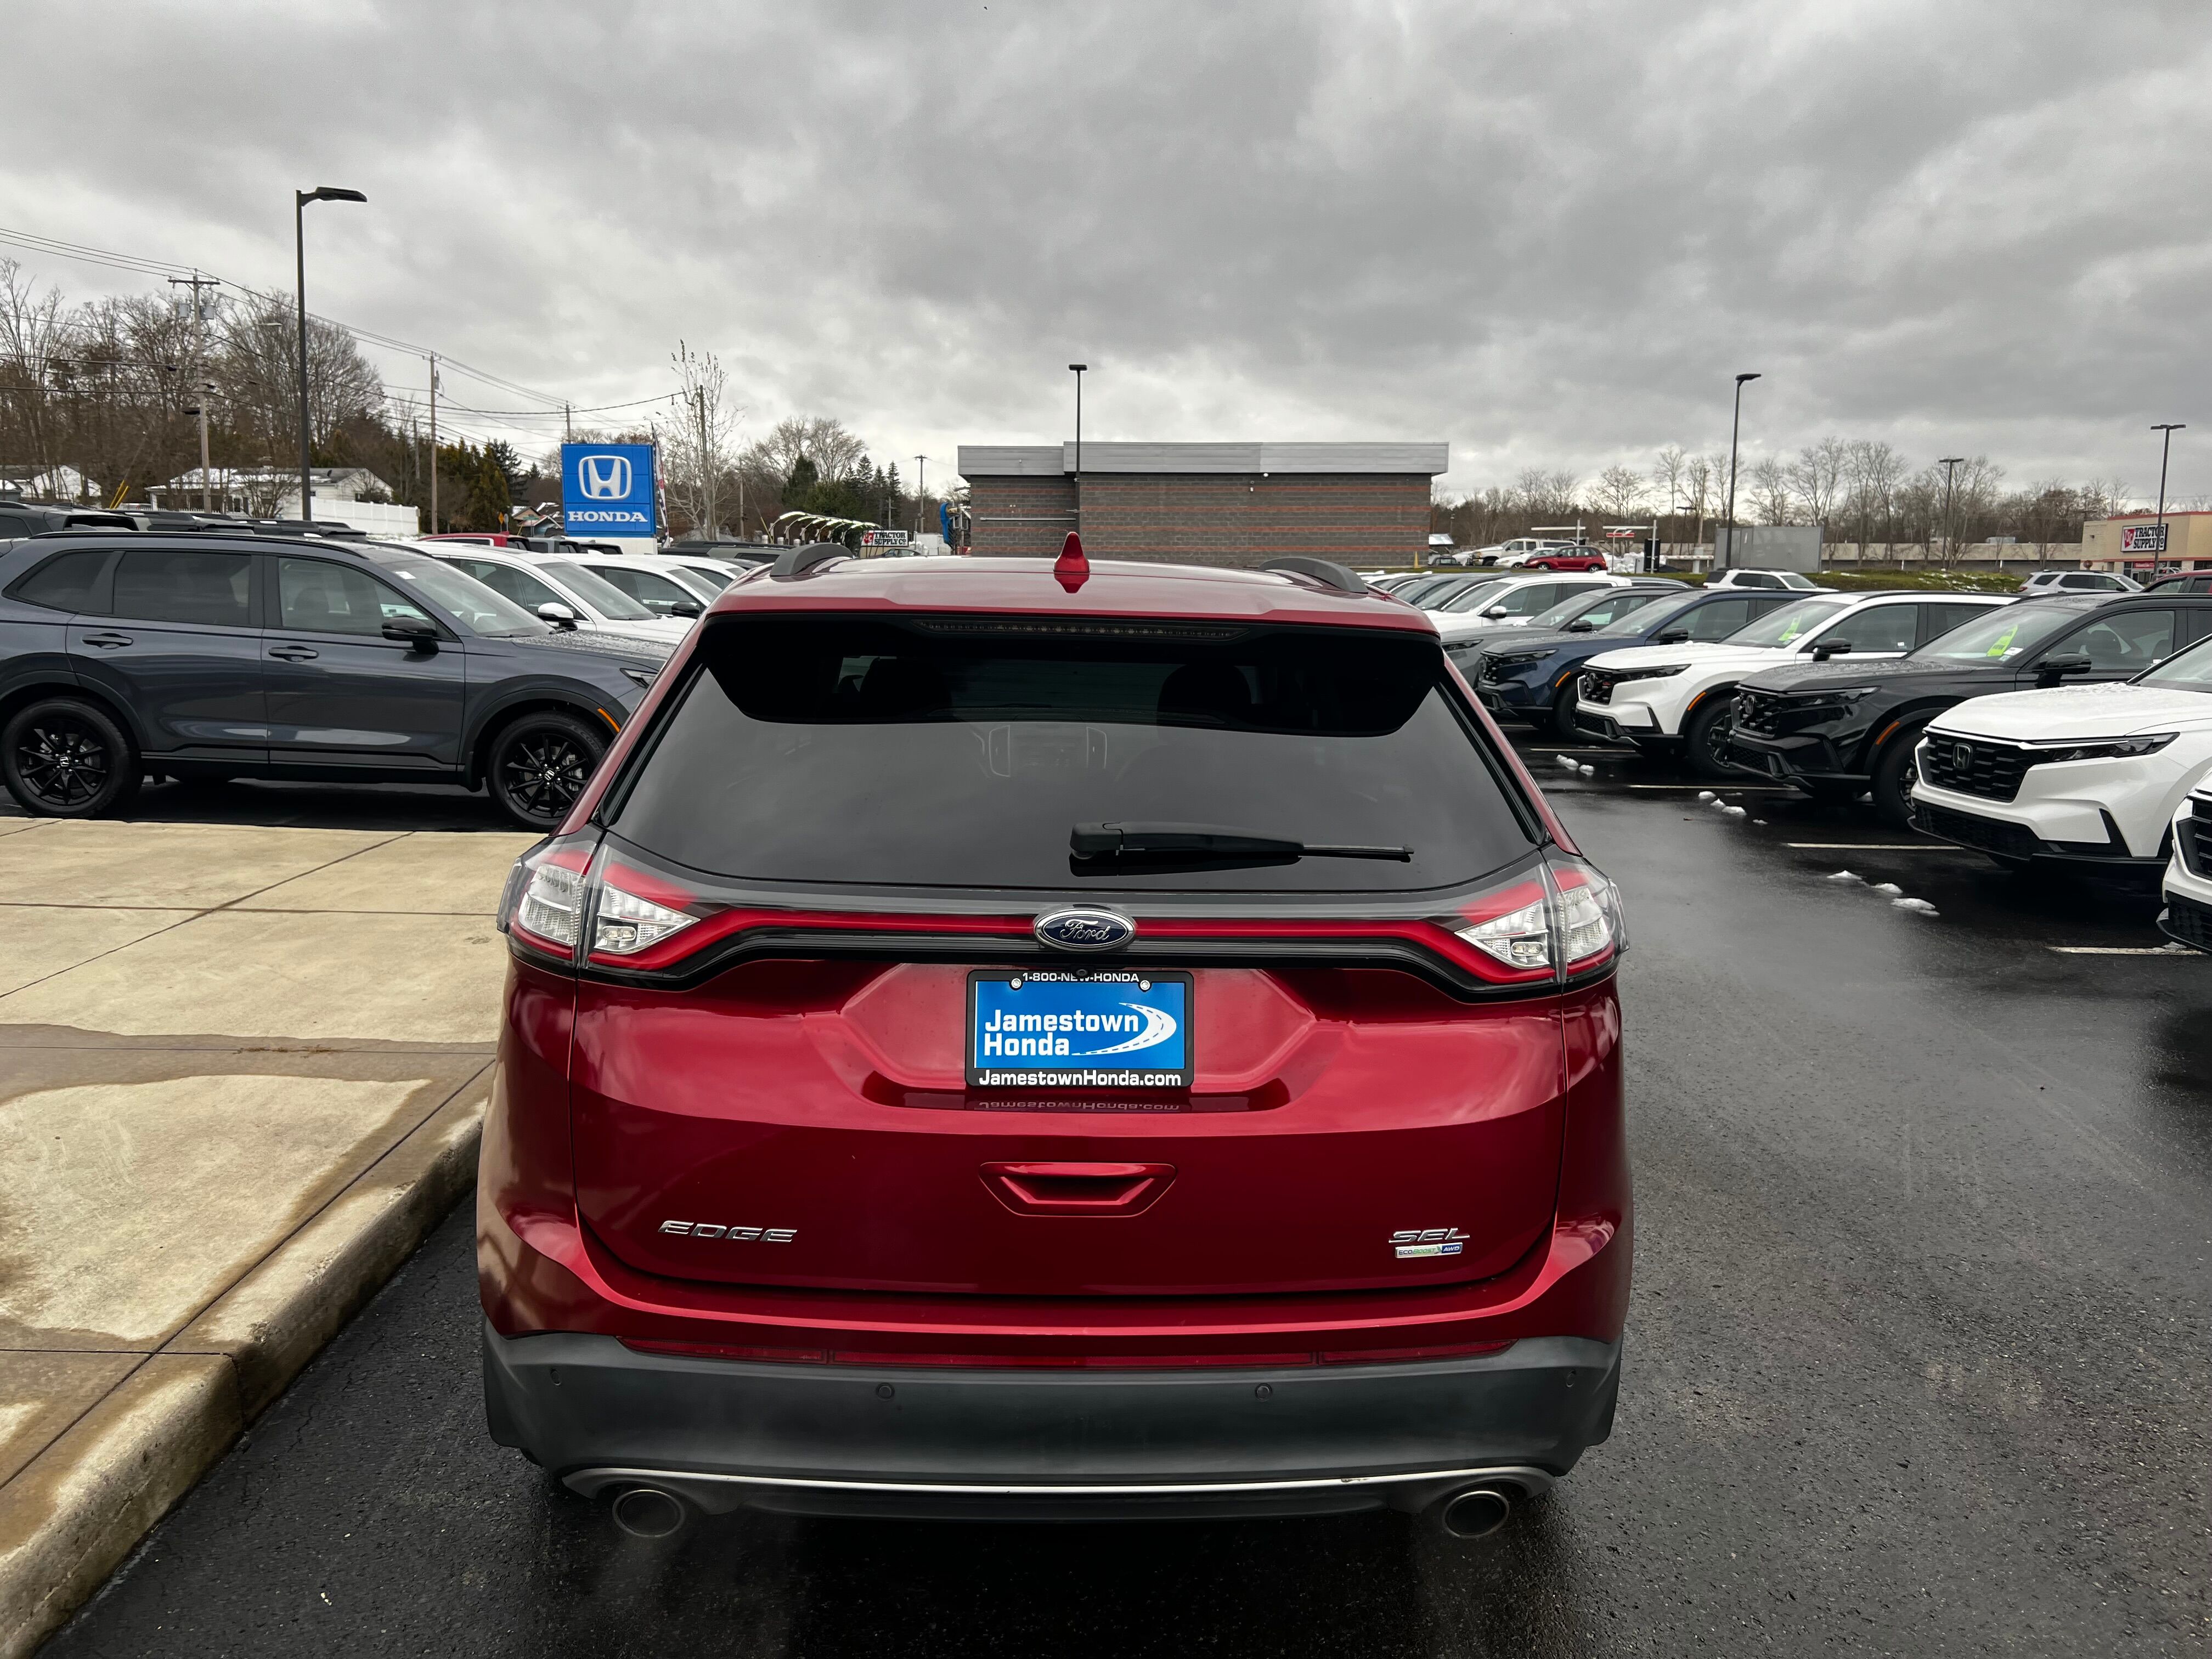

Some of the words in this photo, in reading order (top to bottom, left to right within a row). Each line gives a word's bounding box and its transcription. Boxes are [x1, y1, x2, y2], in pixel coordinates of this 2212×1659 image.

[568, 511, 648, 522] HONDA
[2133, 538, 2157, 549] SUPPLY
[1060, 918, 1111, 940] Ford
[985, 1009, 1139, 1032] Jamestown
[984, 1032, 1070, 1056] Honda
[979, 1069, 1181, 1086] JamestownHonda.com
[658, 1220, 798, 1243] EDGE
[1389, 1227, 1470, 1243] SEL
